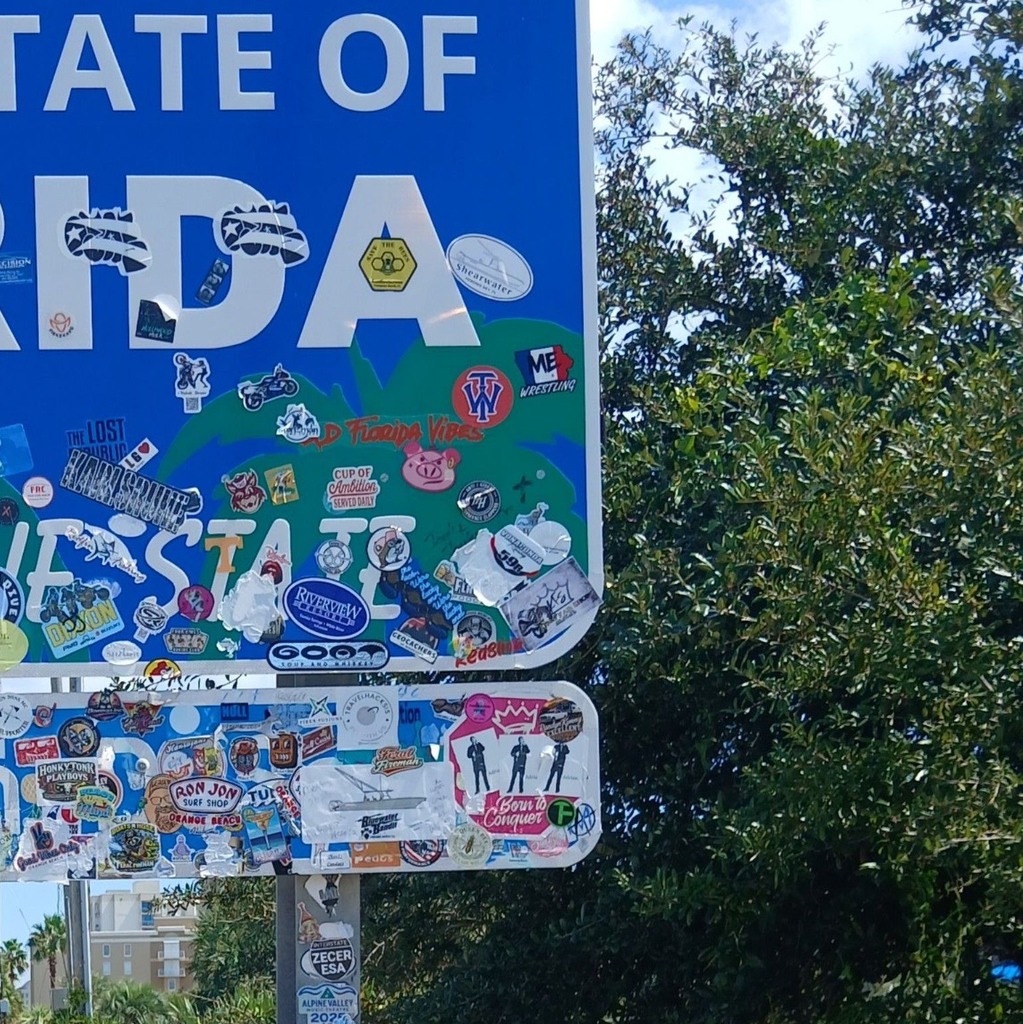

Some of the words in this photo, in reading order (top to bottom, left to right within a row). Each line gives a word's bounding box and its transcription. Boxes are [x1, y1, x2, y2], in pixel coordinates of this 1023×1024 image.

[318, 13, 477, 112] OF
[455, 261, 513, 297] Shearwater
[519, 379, 577, 399] WRESTLING
[87, 418, 125, 444] LOST
[334, 469, 355, 479] CUP
[357, 467, 371, 478] OF
[328, 479, 378, 496] Ambition
[333, 496, 358, 508] SERVED
[357, 495, 377, 507] DAILY
[1, 578, 21, 618] DIVE
[294, 586, 363, 620] RIVERVIEW
[391, 631, 437, 660] GEOCACHERS
[280, 660, 305, 668] SOUP
[310, 660, 330, 668] AND
[39, 761, 70, 776] HONKY
[71, 761, 96, 774] TONK
[46, 772, 89, 783] PLAYBOYS
[176, 782, 205, 797] RON
[207, 782, 239, 799] JON
[183, 798, 204, 808] SURF
[206, 798, 230, 808] SHOP
[498, 796, 533, 813] Born
[169, 813, 210, 826] ORANGE
[211, 814, 241, 826] BEACH
[483, 808, 545, 832] Conquer
[311, 949, 352, 965] ZECER
[320, 963, 347, 976] ESA
[302, 1000, 327, 1008] ALPINE
[327, 999, 354, 1007] VALLEY
